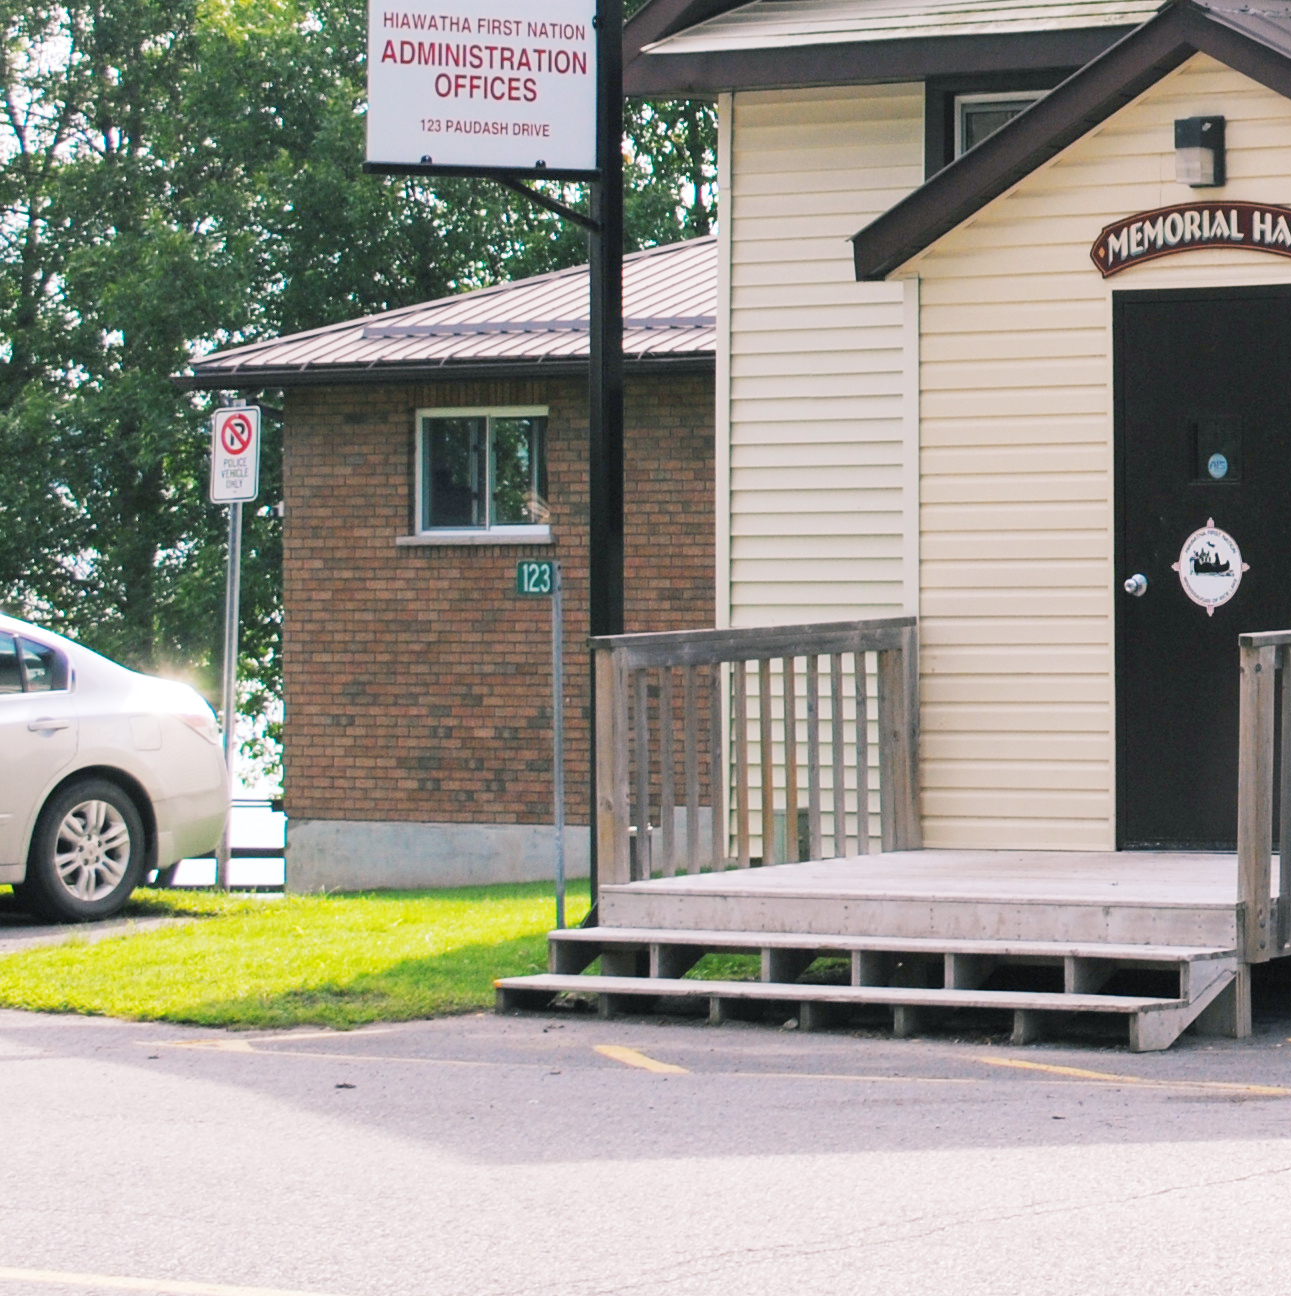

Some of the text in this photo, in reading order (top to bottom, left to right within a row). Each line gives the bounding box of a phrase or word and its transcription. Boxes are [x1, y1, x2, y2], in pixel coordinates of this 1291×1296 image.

[383, 12, 586, 40] HIAWATHA FIRST NATION
[381, 39, 588, 75] ADMINISTRATION
[434, 73, 538, 103] OFFICES
[420, 119, 550, 137] 123 PAUDASH DRIVE
[1107, 209, 1245, 267] MEMORIAL
[522, 563, 551, 593] 123
